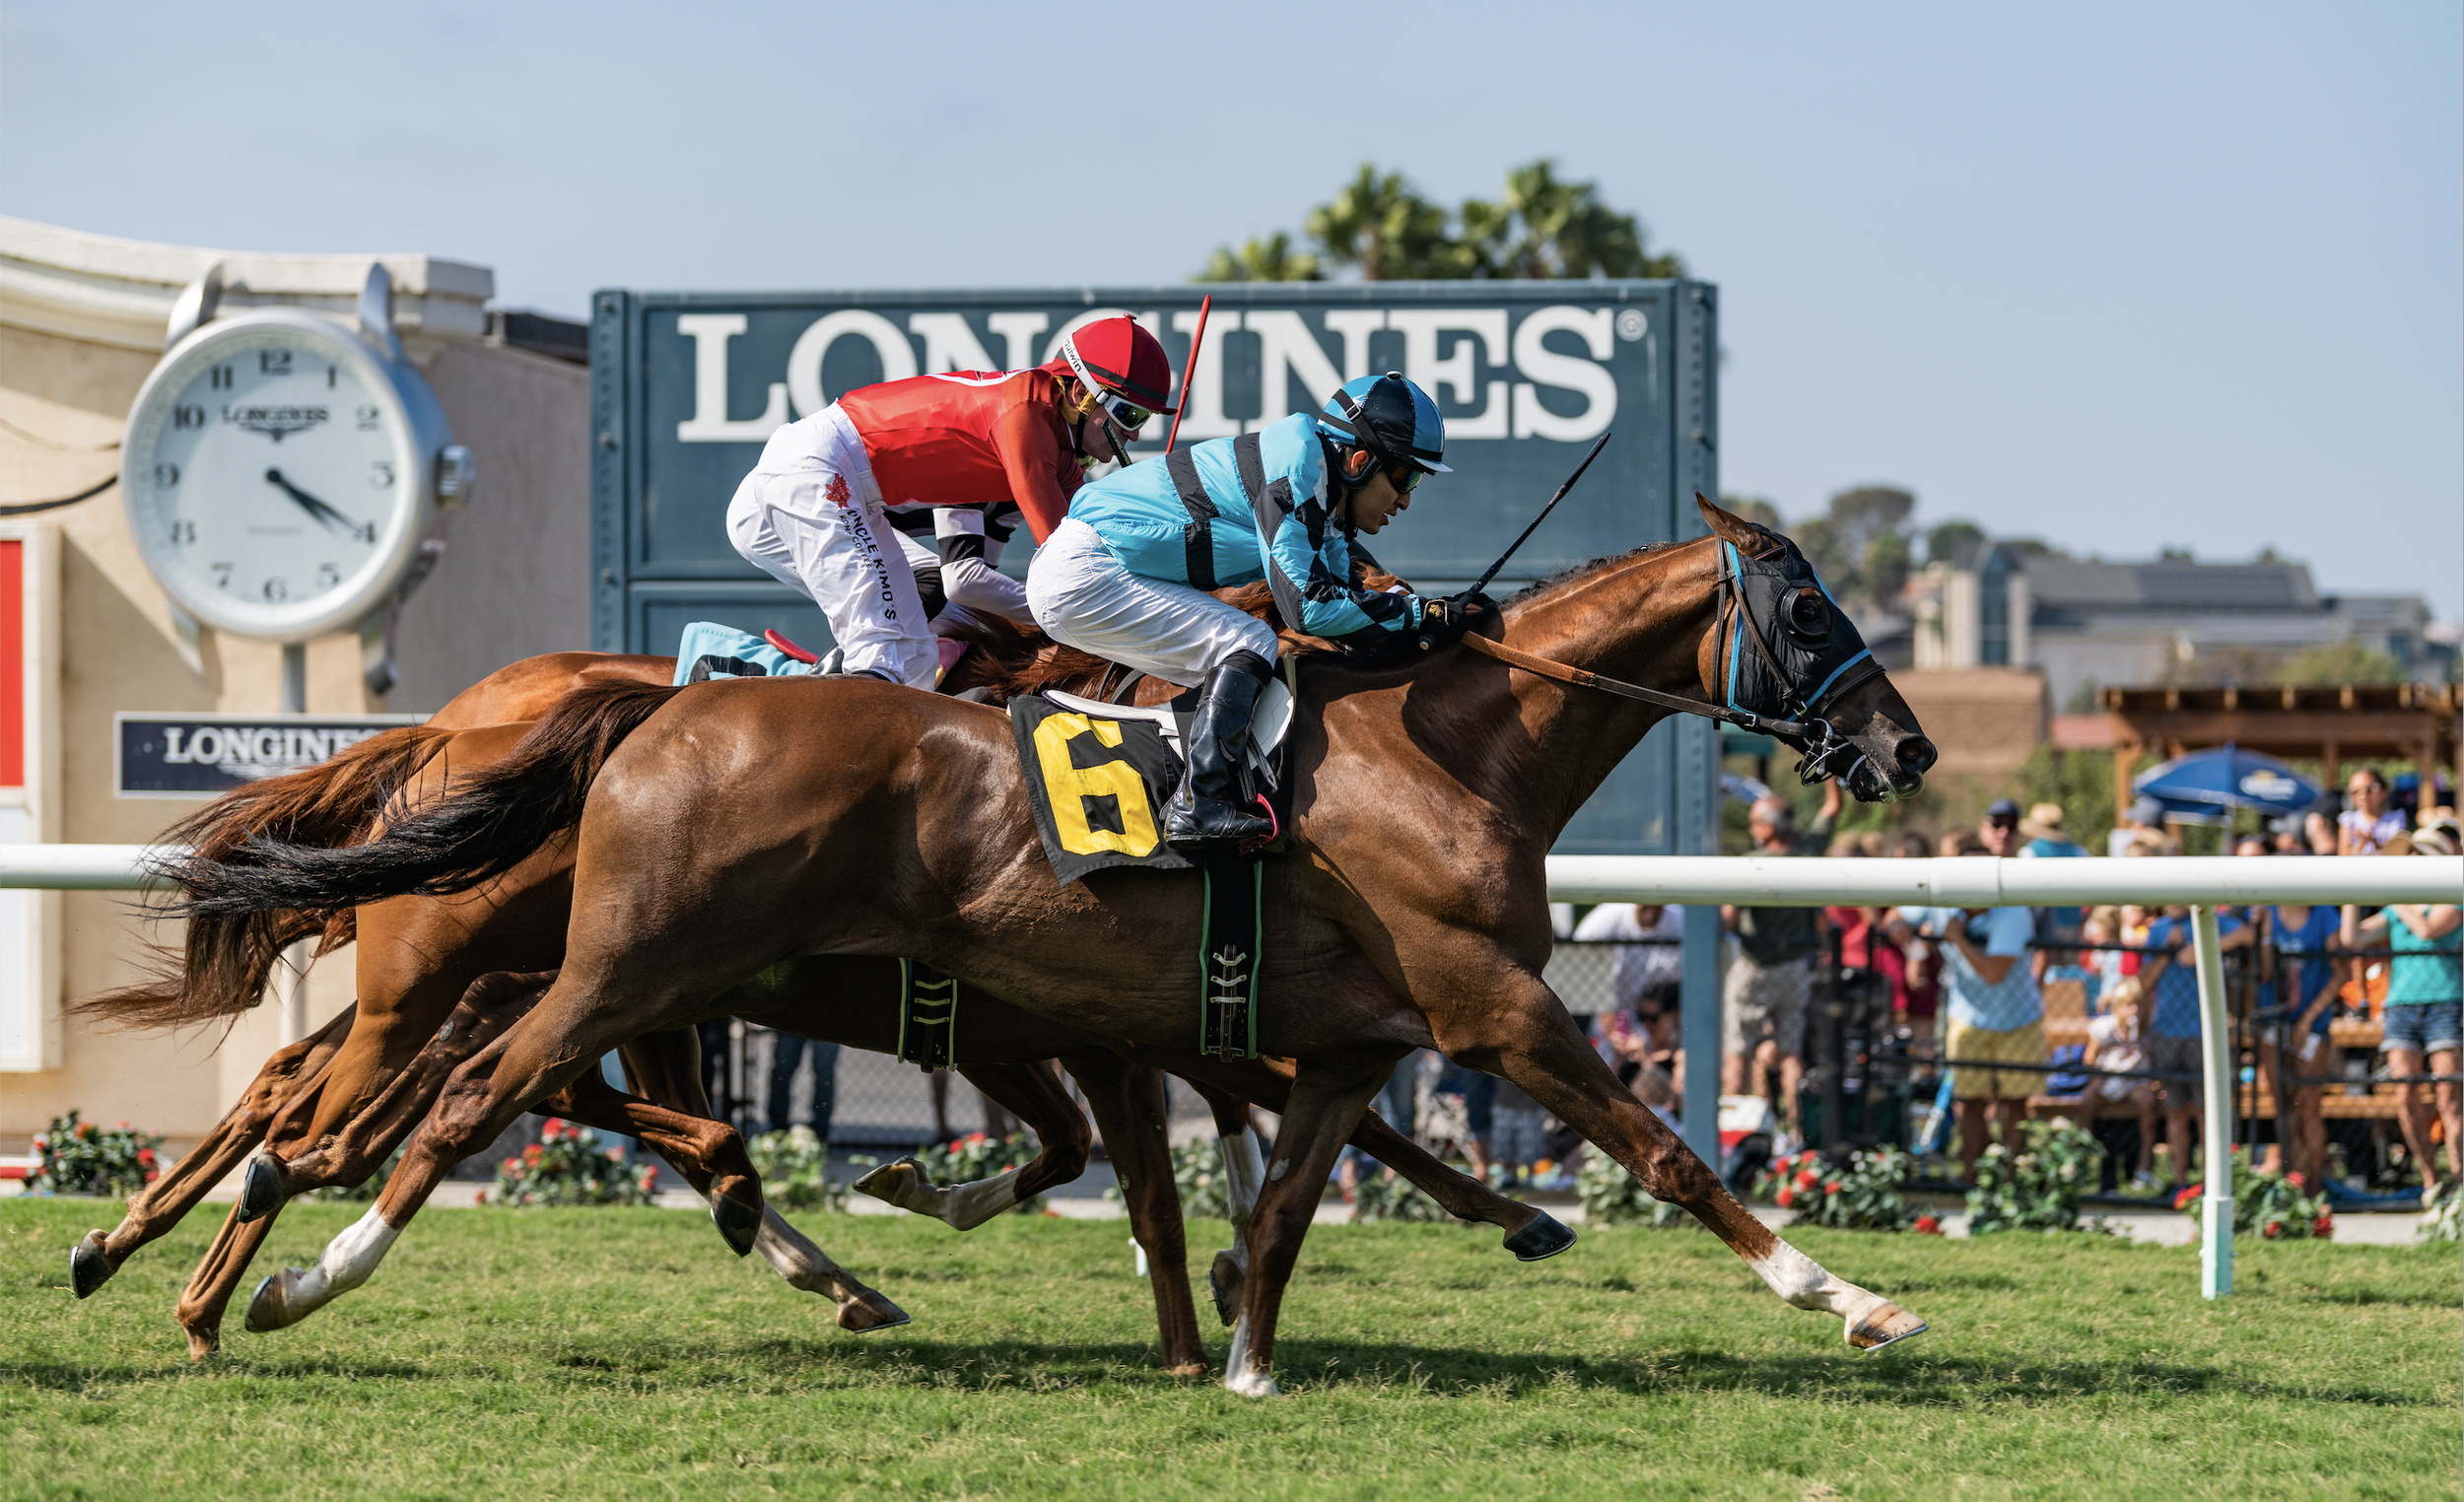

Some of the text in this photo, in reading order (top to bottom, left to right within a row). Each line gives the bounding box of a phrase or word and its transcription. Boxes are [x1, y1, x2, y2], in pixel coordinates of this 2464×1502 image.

[259, 349, 292, 375] 12
[1065, 337, 1081, 372] quiwin
[211, 366, 233, 389] 11
[327, 366, 337, 389] 1
[677, 306, 1617, 443] LOINES
[173, 405, 204, 429] 10
[222, 405, 329, 424] LONGINES
[356, 405, 379, 430] 2
[1107, 423, 1131, 465] esormeaux
[155, 461, 179, 489] 9
[369, 462, 394, 490] 3
[171, 521, 195, 542] 8
[847, 510, 897, 621] UNCLE KIMO'S
[852, 536, 872, 569] COFFEE
[211, 563, 234, 586] 7
[318, 563, 339, 588] 5
[263, 577, 287, 599] 6
[163, 726, 382, 765] LONGIN
[1033, 712, 1159, 857] 6
